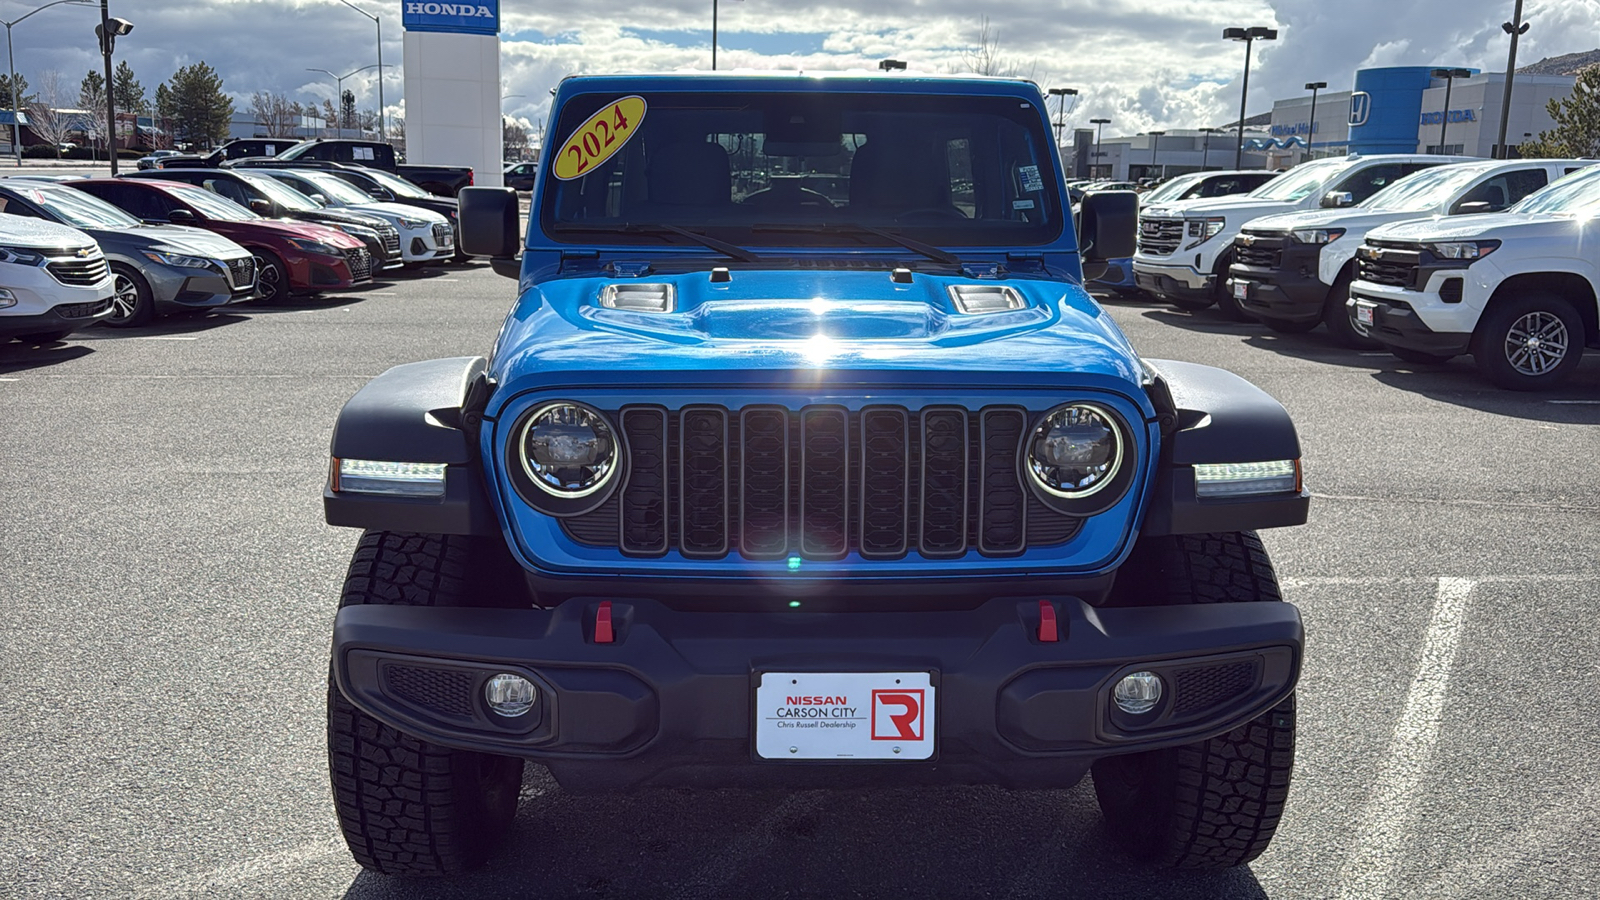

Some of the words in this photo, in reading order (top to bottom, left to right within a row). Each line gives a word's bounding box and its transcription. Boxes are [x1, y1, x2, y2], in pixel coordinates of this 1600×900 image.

[406, 3, 494, 18] HONDA
[1421, 109, 1475, 125] HONDA
[568, 104, 628, 173] 2024
[786, 696, 847, 705] NISSAN
[776, 707, 828, 718] CARSON
[831, 707, 857, 717] CITY
[820, 721, 856, 729] Dealership
